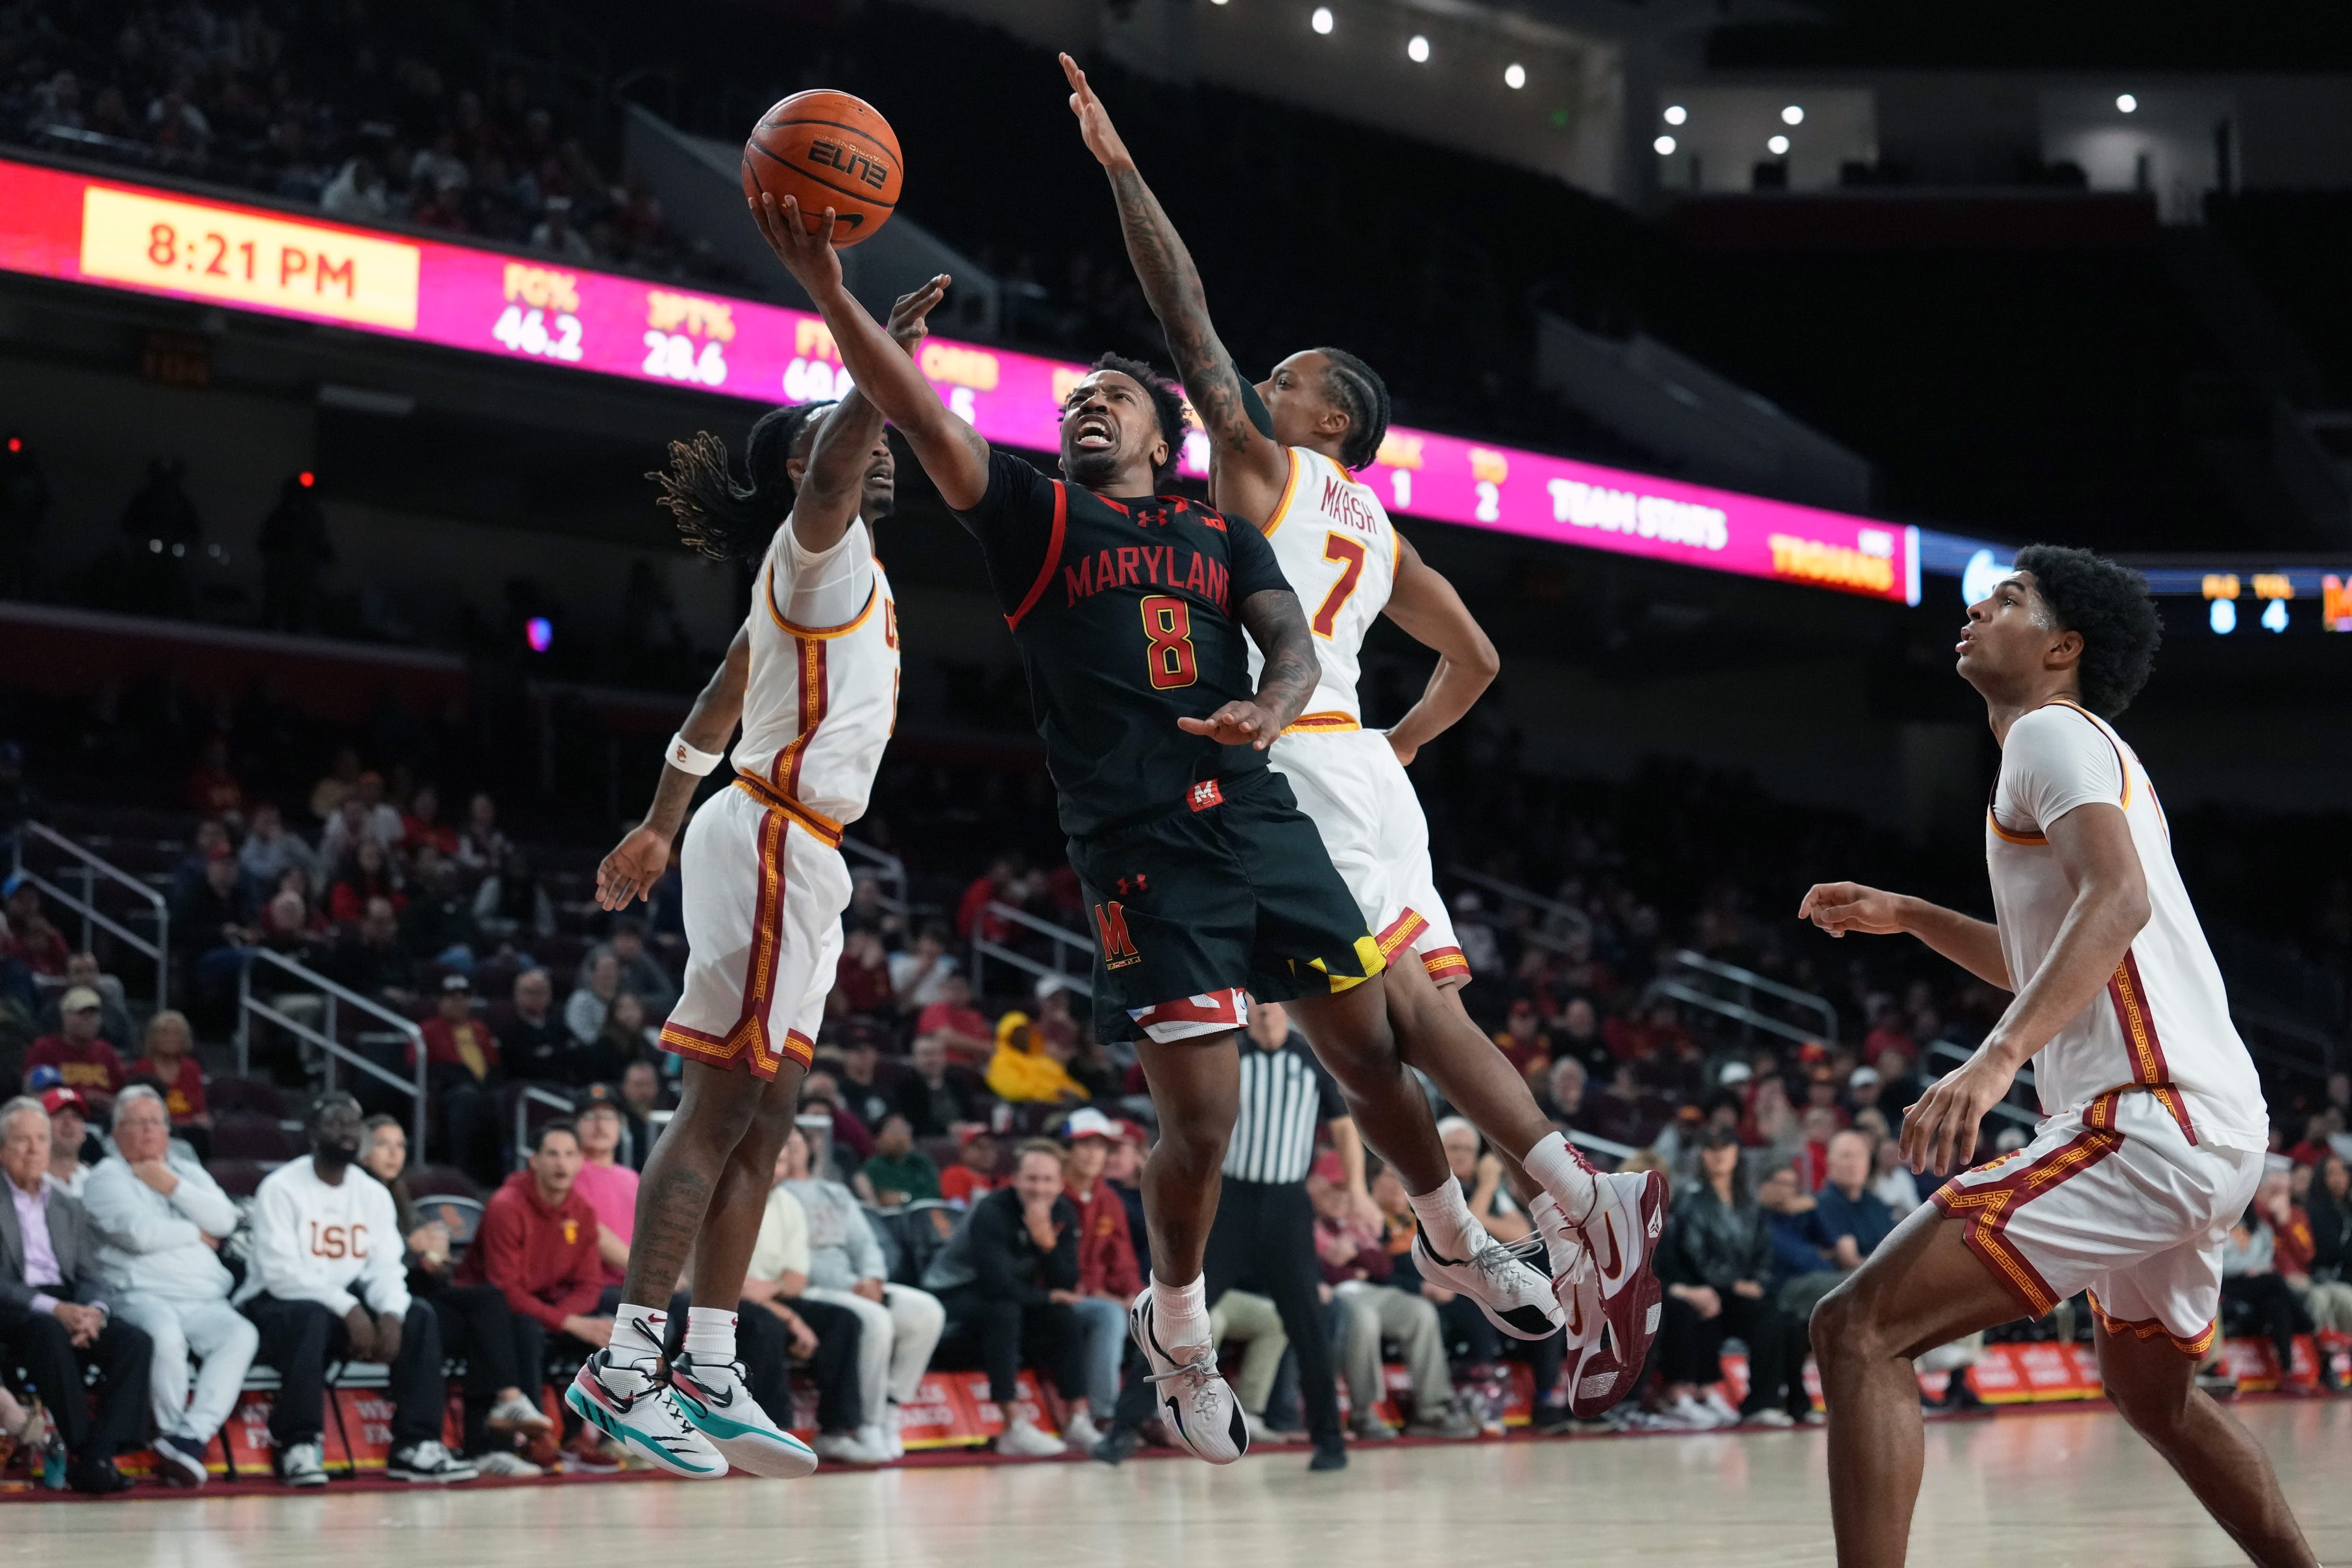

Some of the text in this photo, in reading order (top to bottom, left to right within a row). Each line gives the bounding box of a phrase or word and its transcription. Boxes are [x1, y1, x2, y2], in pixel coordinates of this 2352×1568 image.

[807, 140, 888, 190] ELITE
[148, 223, 354, 299] 8:21 PM
[492, 304, 583, 361] 46.2
[1319, 474, 1378, 535] MARSH
[1390, 468, 1412, 509] 1
[1475, 480, 1500, 522] 2
[1547, 477, 1729, 551] TEAM STATS
[1311, 528, 1367, 641] 7
[1140, 594, 1199, 691] 8
[2260, 597, 2290, 634] 4
[311, 1220, 369, 1259] USC
